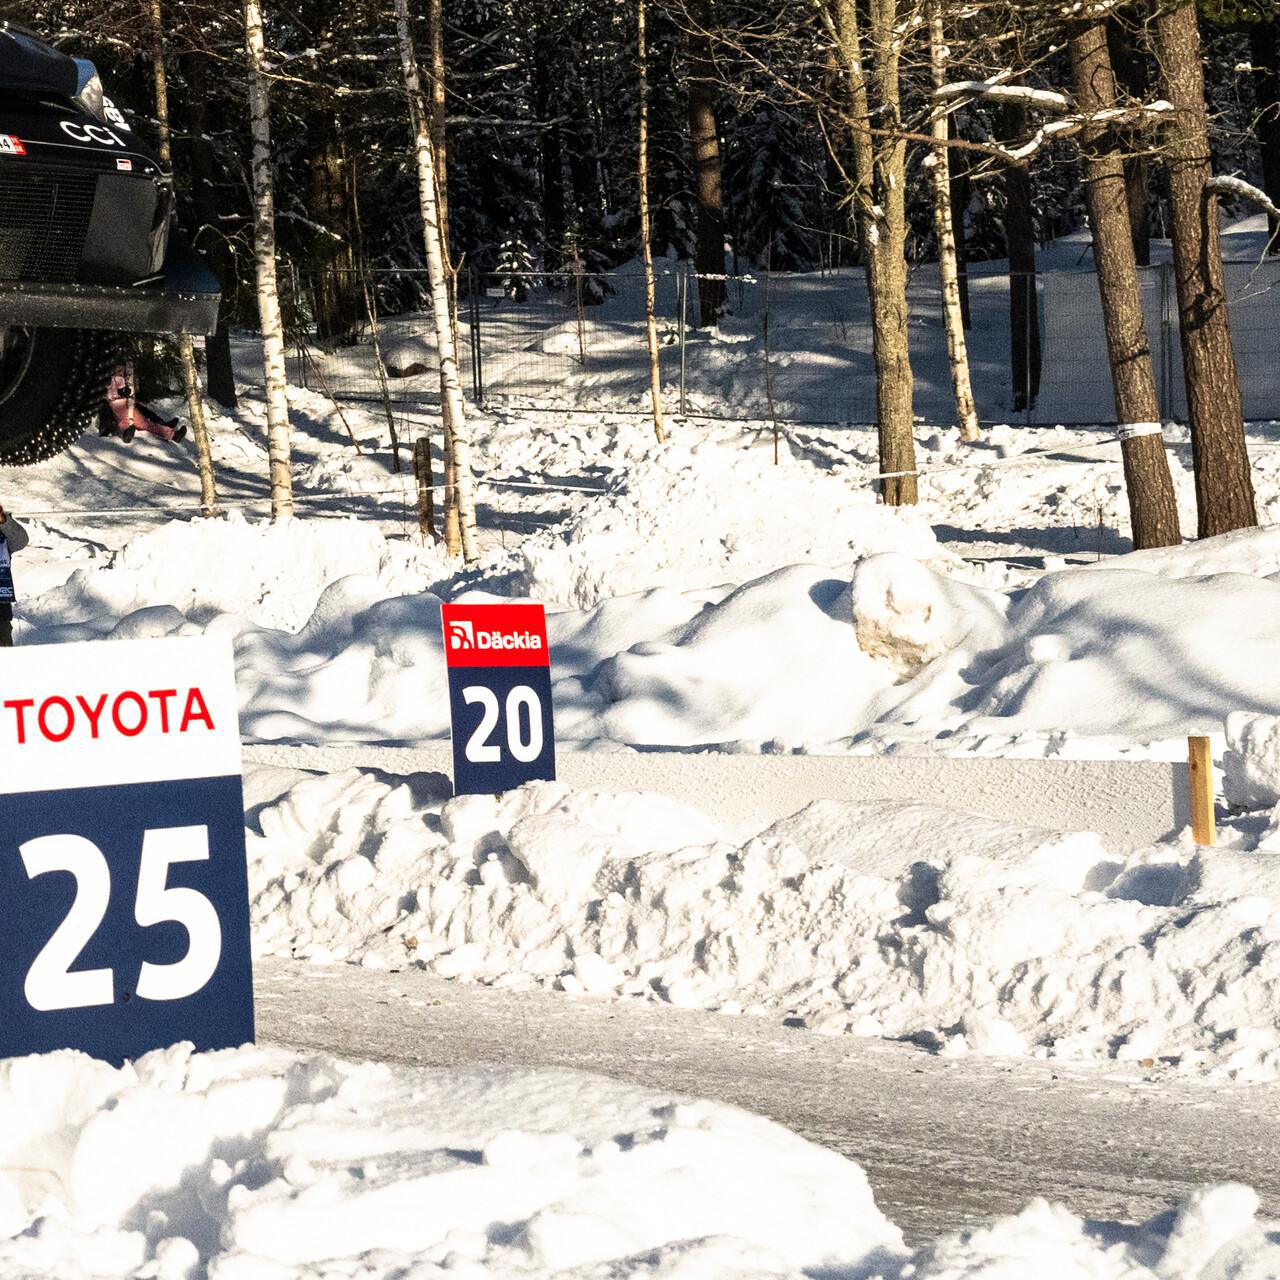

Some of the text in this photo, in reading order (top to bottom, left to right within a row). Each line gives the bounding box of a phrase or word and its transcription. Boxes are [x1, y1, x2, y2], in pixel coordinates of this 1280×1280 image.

[477, 631, 542, 650] Däckia
[3, 687, 215, 743] TOYOTA
[462, 685, 544, 763] 20
[19, 824, 222, 1011] 25
